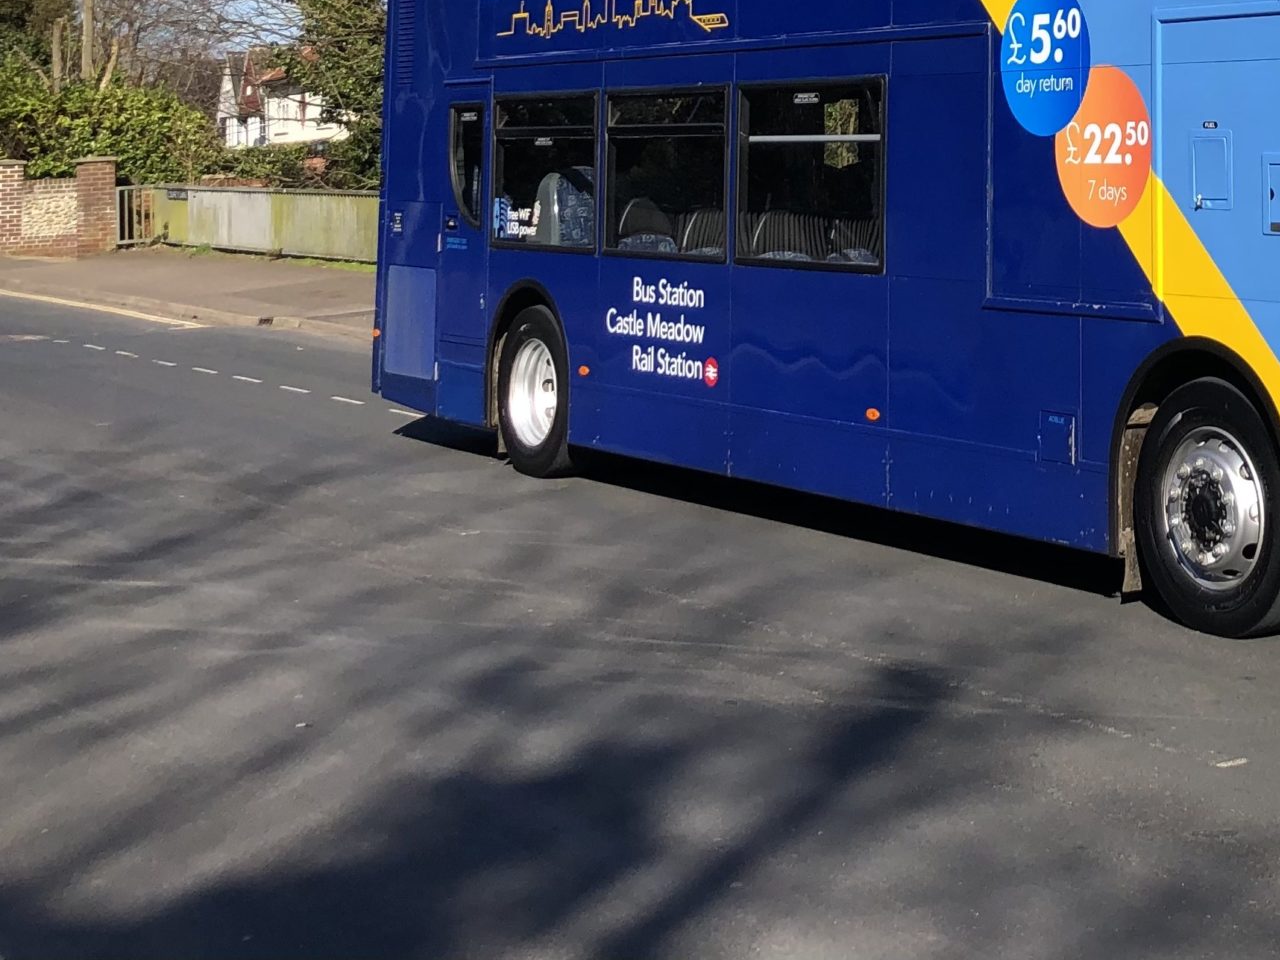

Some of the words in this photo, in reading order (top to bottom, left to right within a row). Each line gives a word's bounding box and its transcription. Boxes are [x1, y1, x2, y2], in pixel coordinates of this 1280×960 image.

[1016, 71, 1038, 98] day
[1038, 74, 1074, 93] return
[1087, 179, 1096, 200] 7
[1098, 178, 1128, 207] days
[632, 276, 656, 303] Bus
[658, 278, 705, 308] Station
[606, 307, 645, 337] Castle
[646, 312, 705, 344] Meadow
[631, 344, 654, 372] Rail
[656, 347, 703, 380] Station
